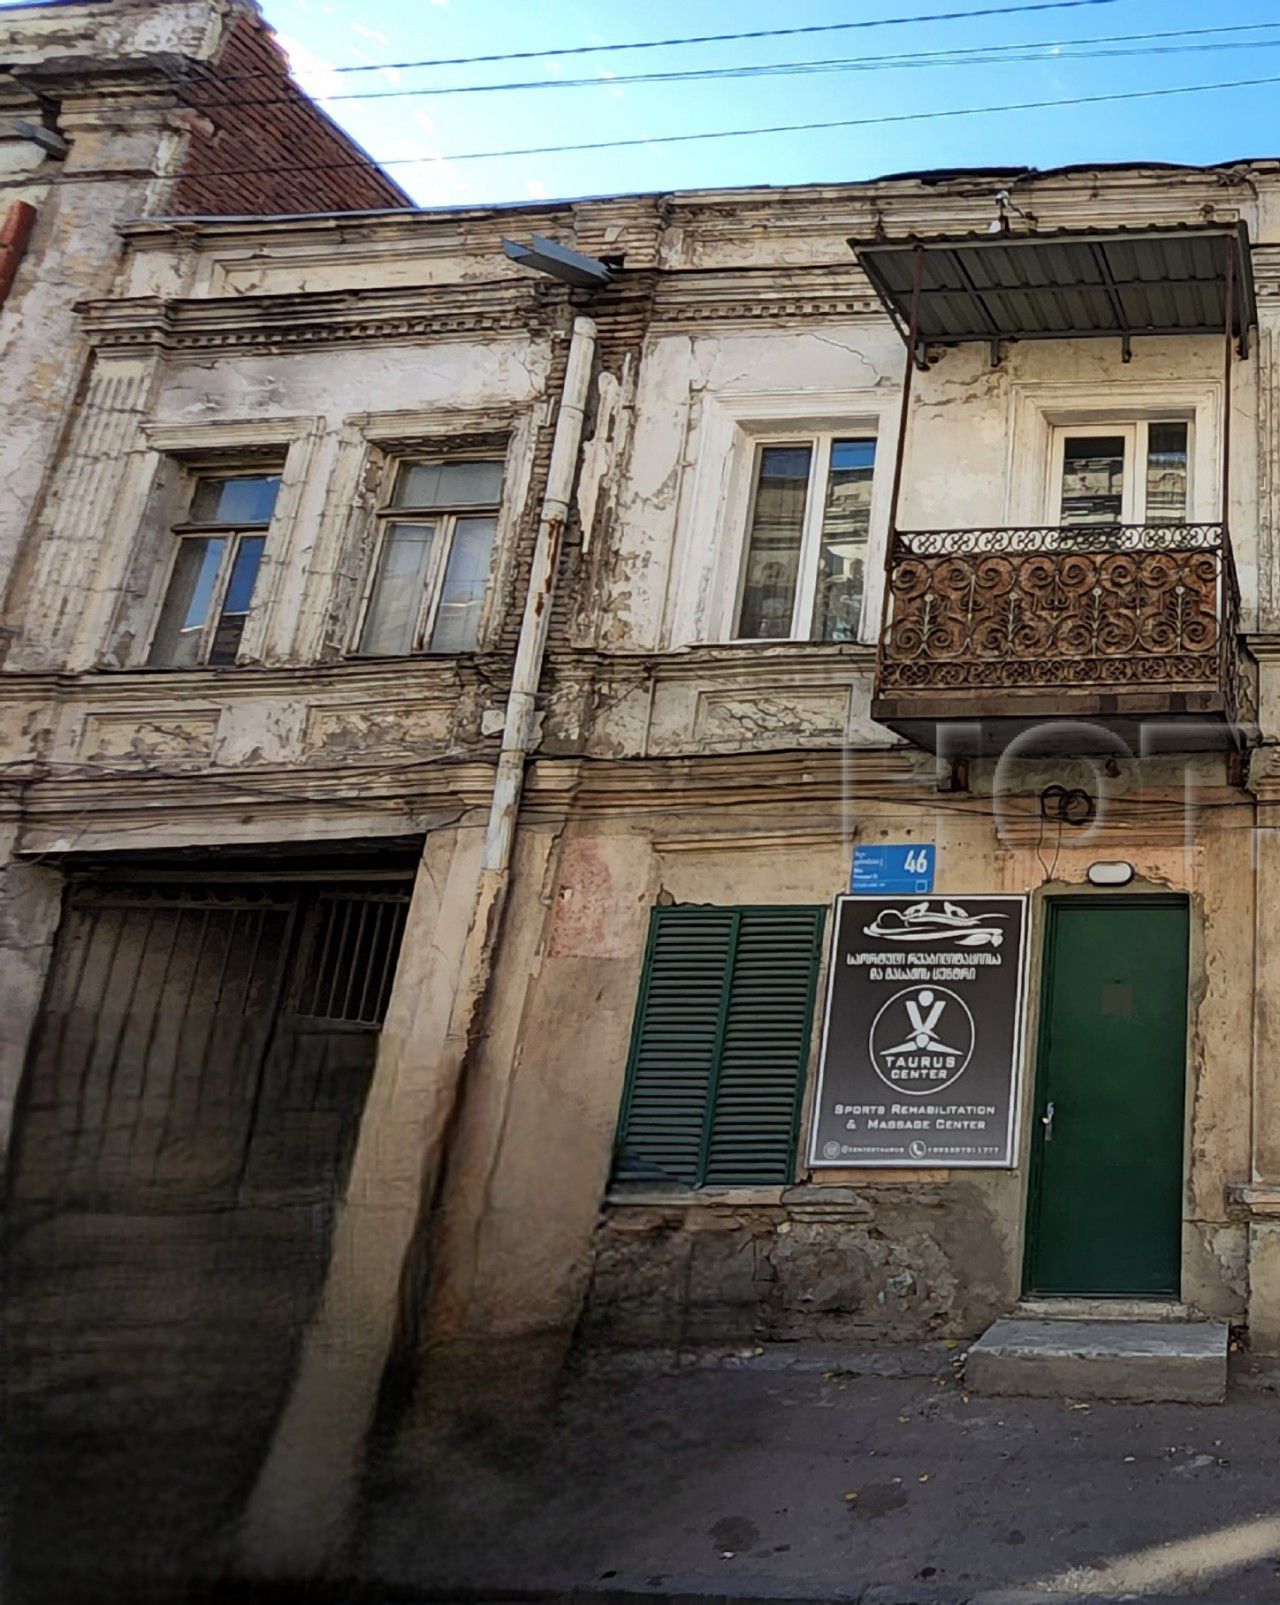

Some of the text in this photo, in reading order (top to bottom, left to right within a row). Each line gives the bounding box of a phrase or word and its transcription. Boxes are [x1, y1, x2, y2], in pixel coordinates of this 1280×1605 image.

[904, 849, 928, 873] 46
[885, 1056, 956, 1068] TAURUS
[890, 1069, 948, 1080] CENTER
[834, 1103, 996, 1115] SPORTS REHABILITATION
[846, 1118, 986, 1130] & MASSAGE CENTER
